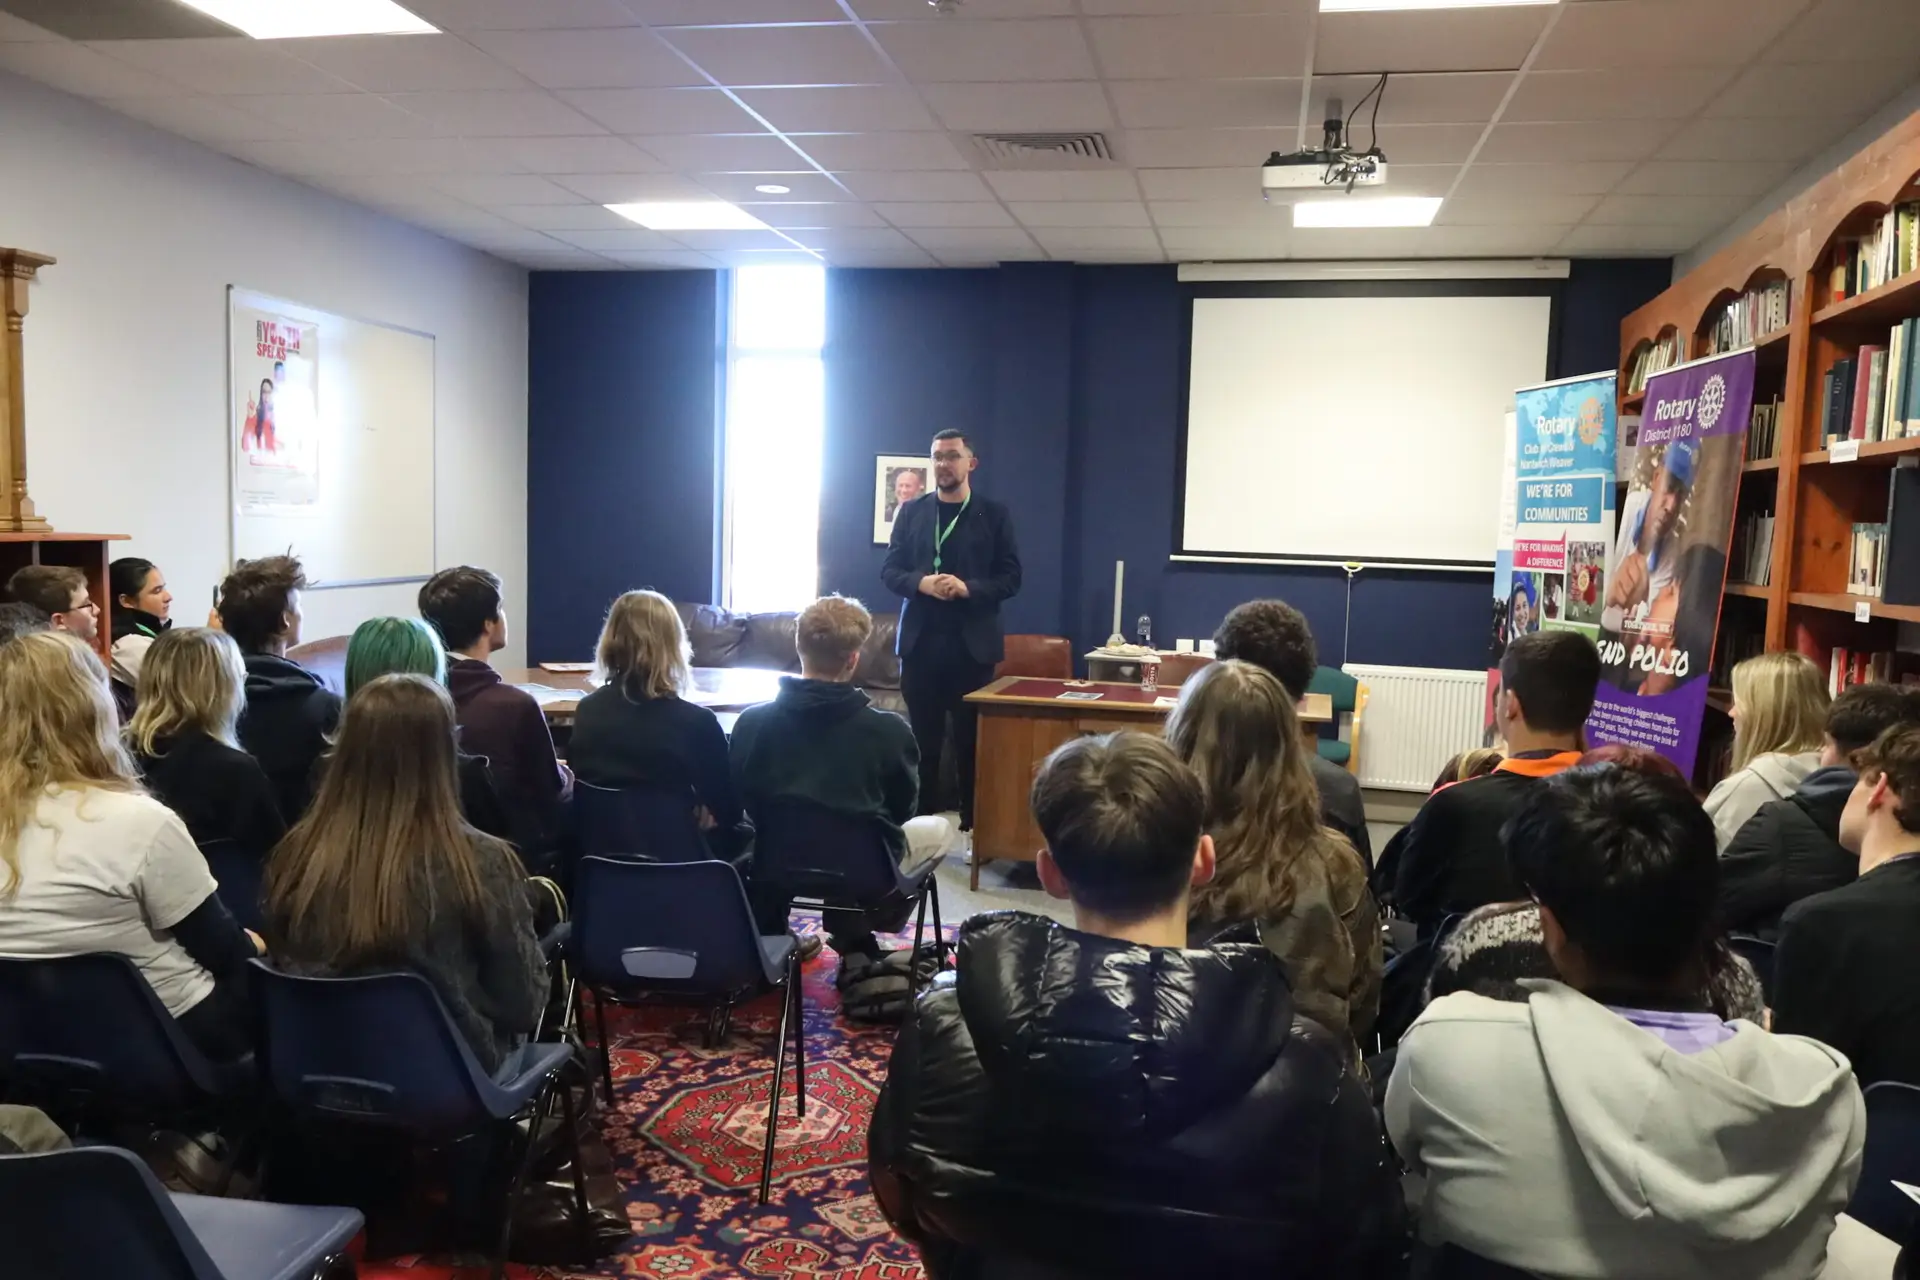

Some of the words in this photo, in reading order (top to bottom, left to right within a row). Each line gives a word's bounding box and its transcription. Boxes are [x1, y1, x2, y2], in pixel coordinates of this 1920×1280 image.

[1654, 398, 1697, 421] Rotary
[1536, 415, 1576, 436] Rotary
[1645, 427, 1671, 442] District
[1673, 423, 1692, 437] 1180
[1526, 484, 1553, 498] WE'RE
[1555, 483, 1573, 497] FOR
[1525, 506, 1588, 521] COMMUNITIES
[1530, 543, 1541, 552] FOR
[1541, 543, 1564, 553] MAKING
[1532, 557, 1564, 567] DIFFERENCE
[1596, 640, 1626, 666] END
[1629, 644, 1689, 677] POLIO
